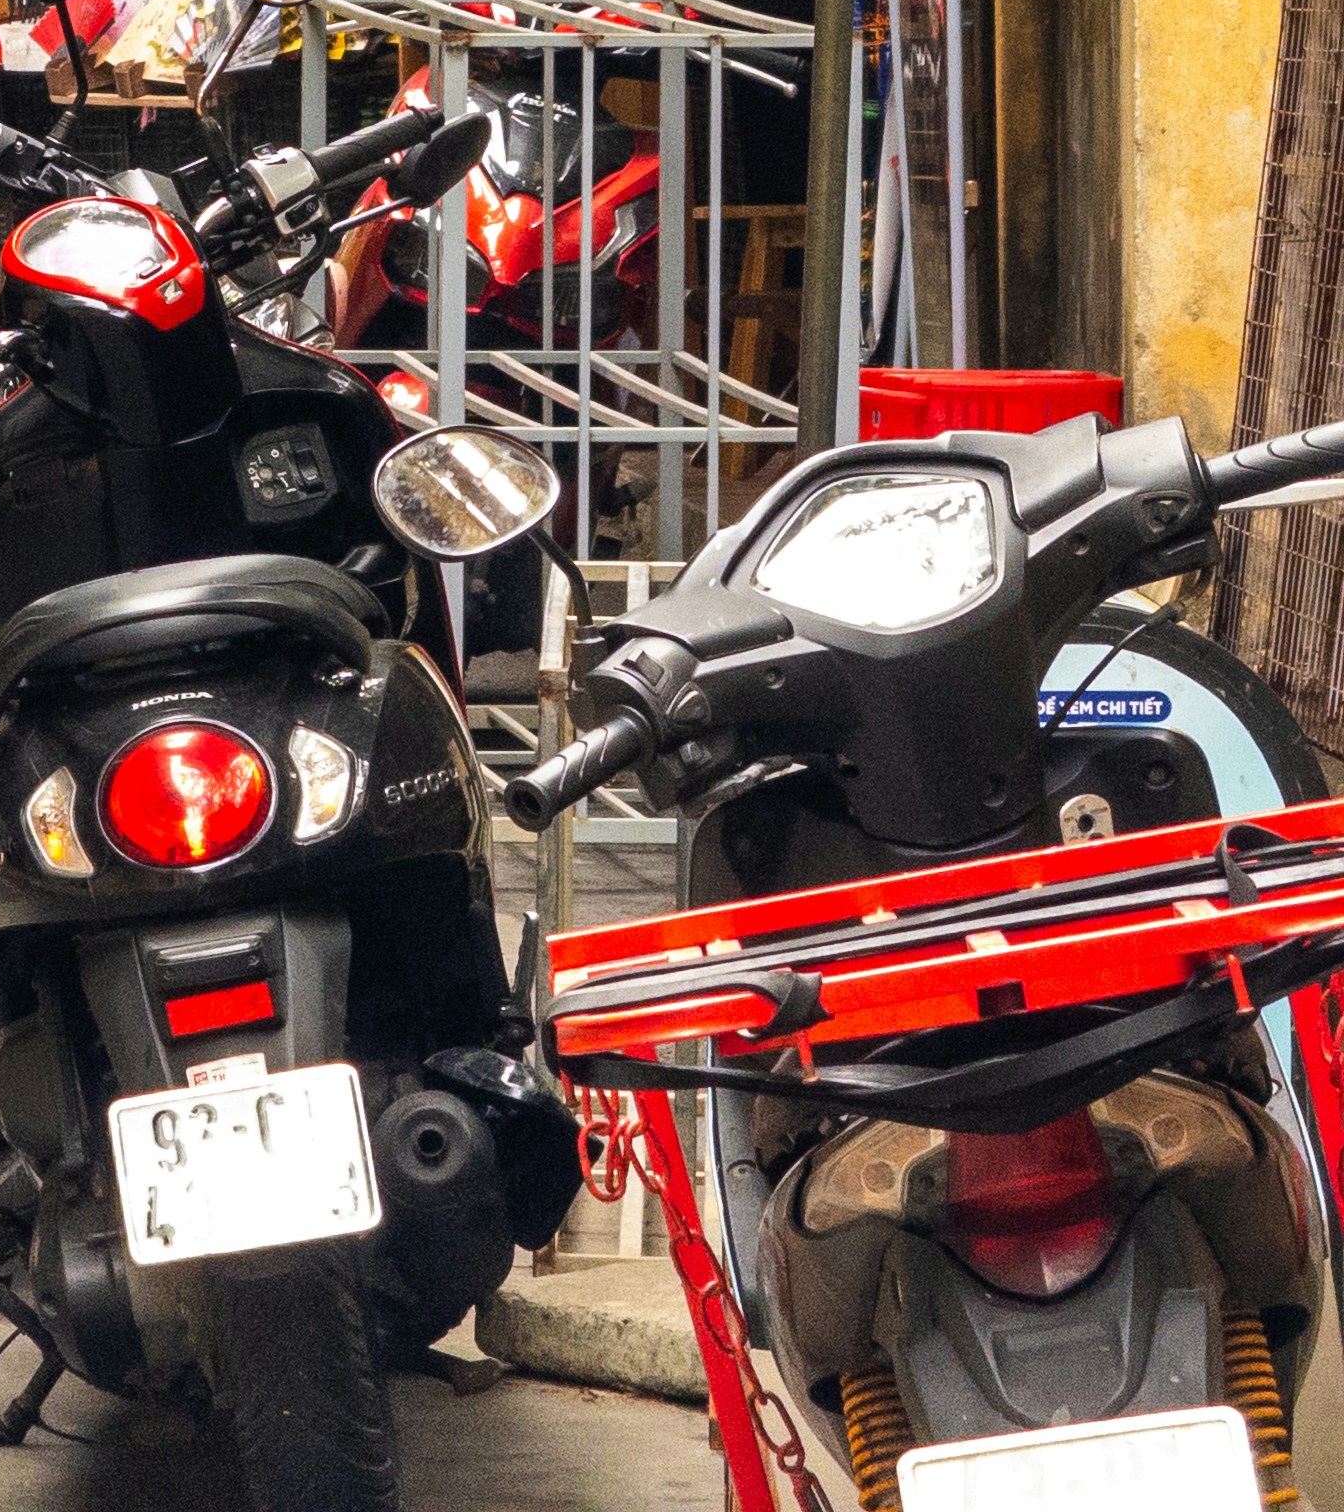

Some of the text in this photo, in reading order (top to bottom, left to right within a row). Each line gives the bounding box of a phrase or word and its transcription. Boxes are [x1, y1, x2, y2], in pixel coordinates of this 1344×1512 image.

[131, 690, 213, 711] HONDA
[1096, 700, 1126, 715] CHI
[1129, 696, 1164, 715] TIẾT
